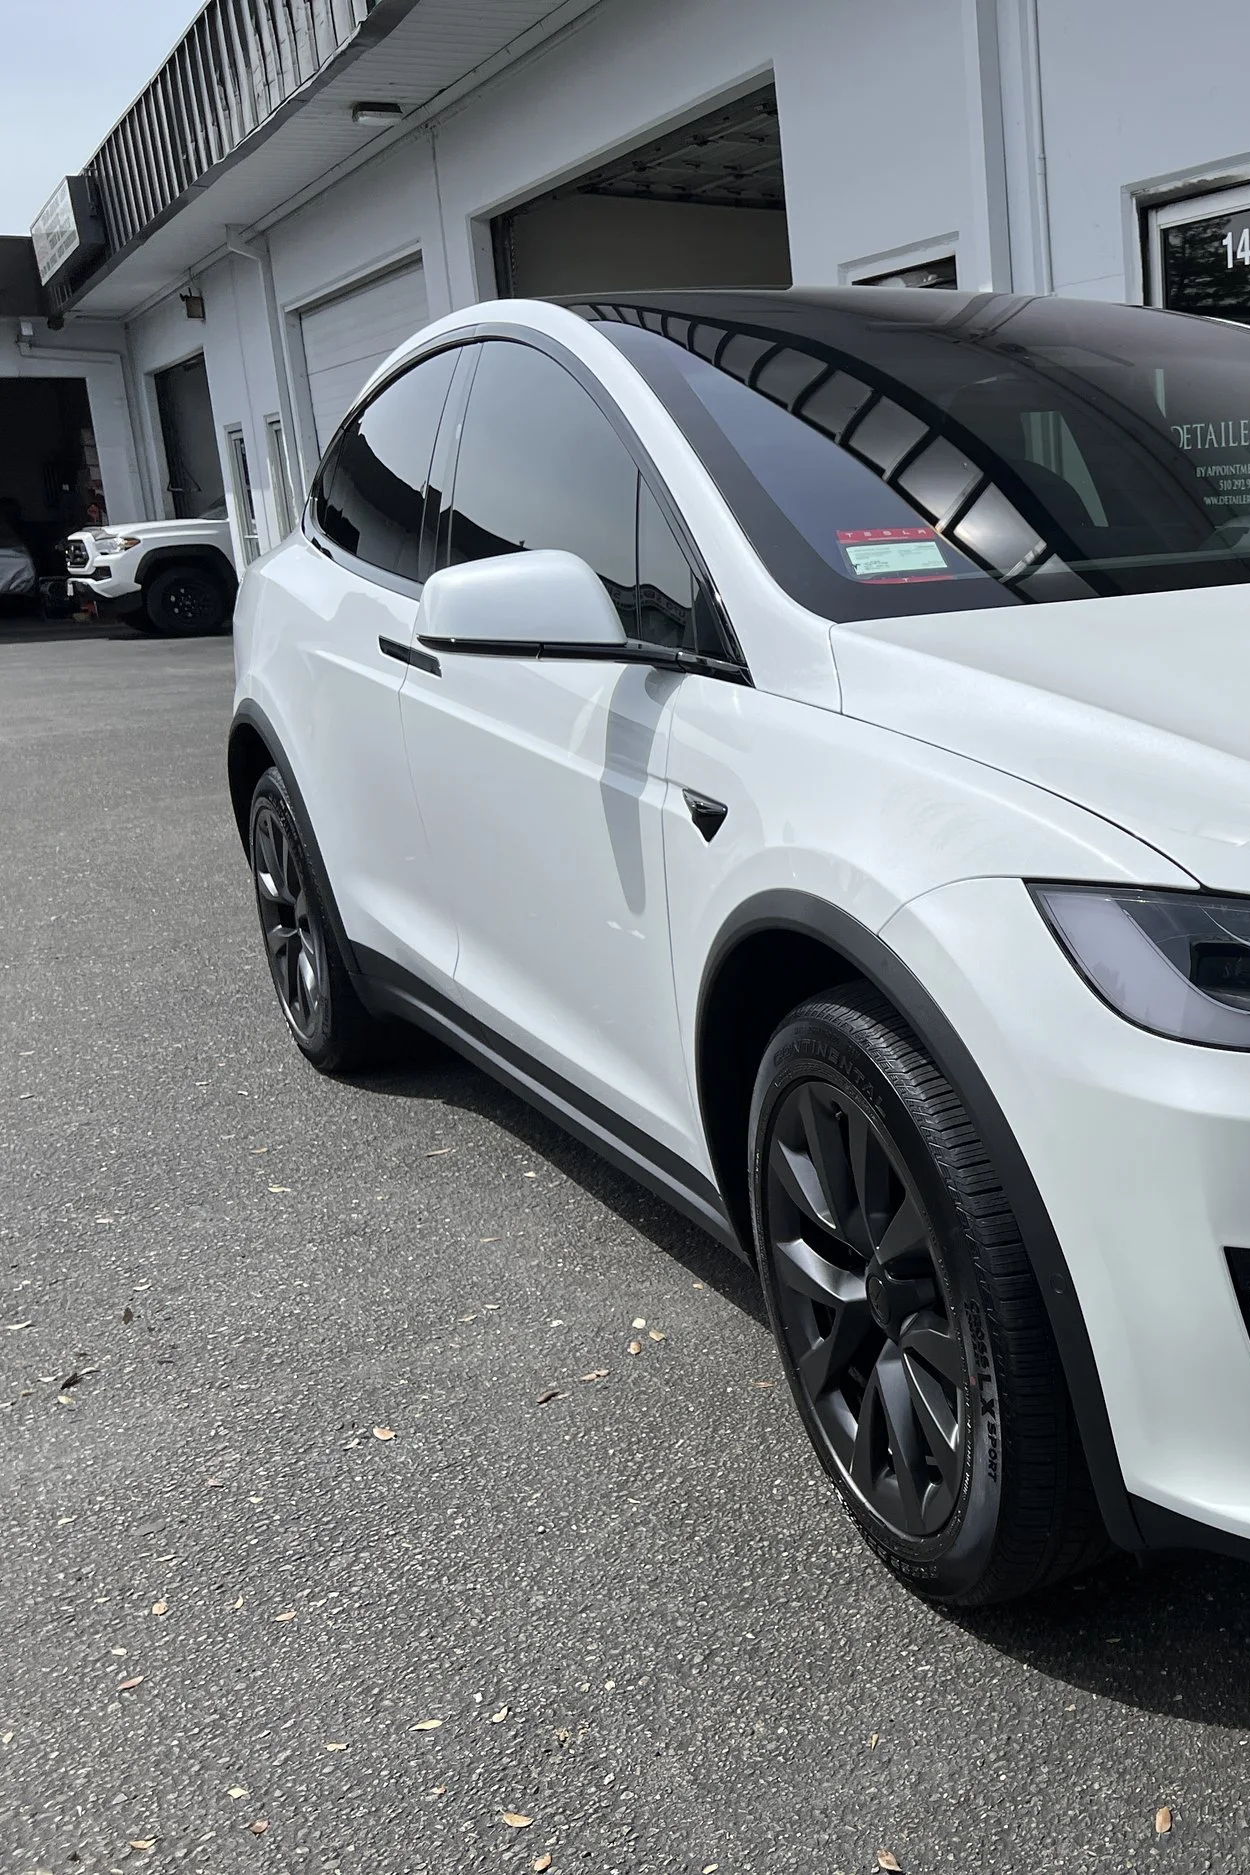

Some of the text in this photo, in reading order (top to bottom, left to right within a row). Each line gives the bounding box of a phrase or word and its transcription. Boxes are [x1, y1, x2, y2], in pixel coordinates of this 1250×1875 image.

[1196, 466, 1206, 477] BY
[1219, 480, 1232, 491] 510
[845, 529, 927, 538] TESLA
[774, 1038, 887, 1118] CONTINENTAL
[986, 1421, 998, 1483] SPORT
